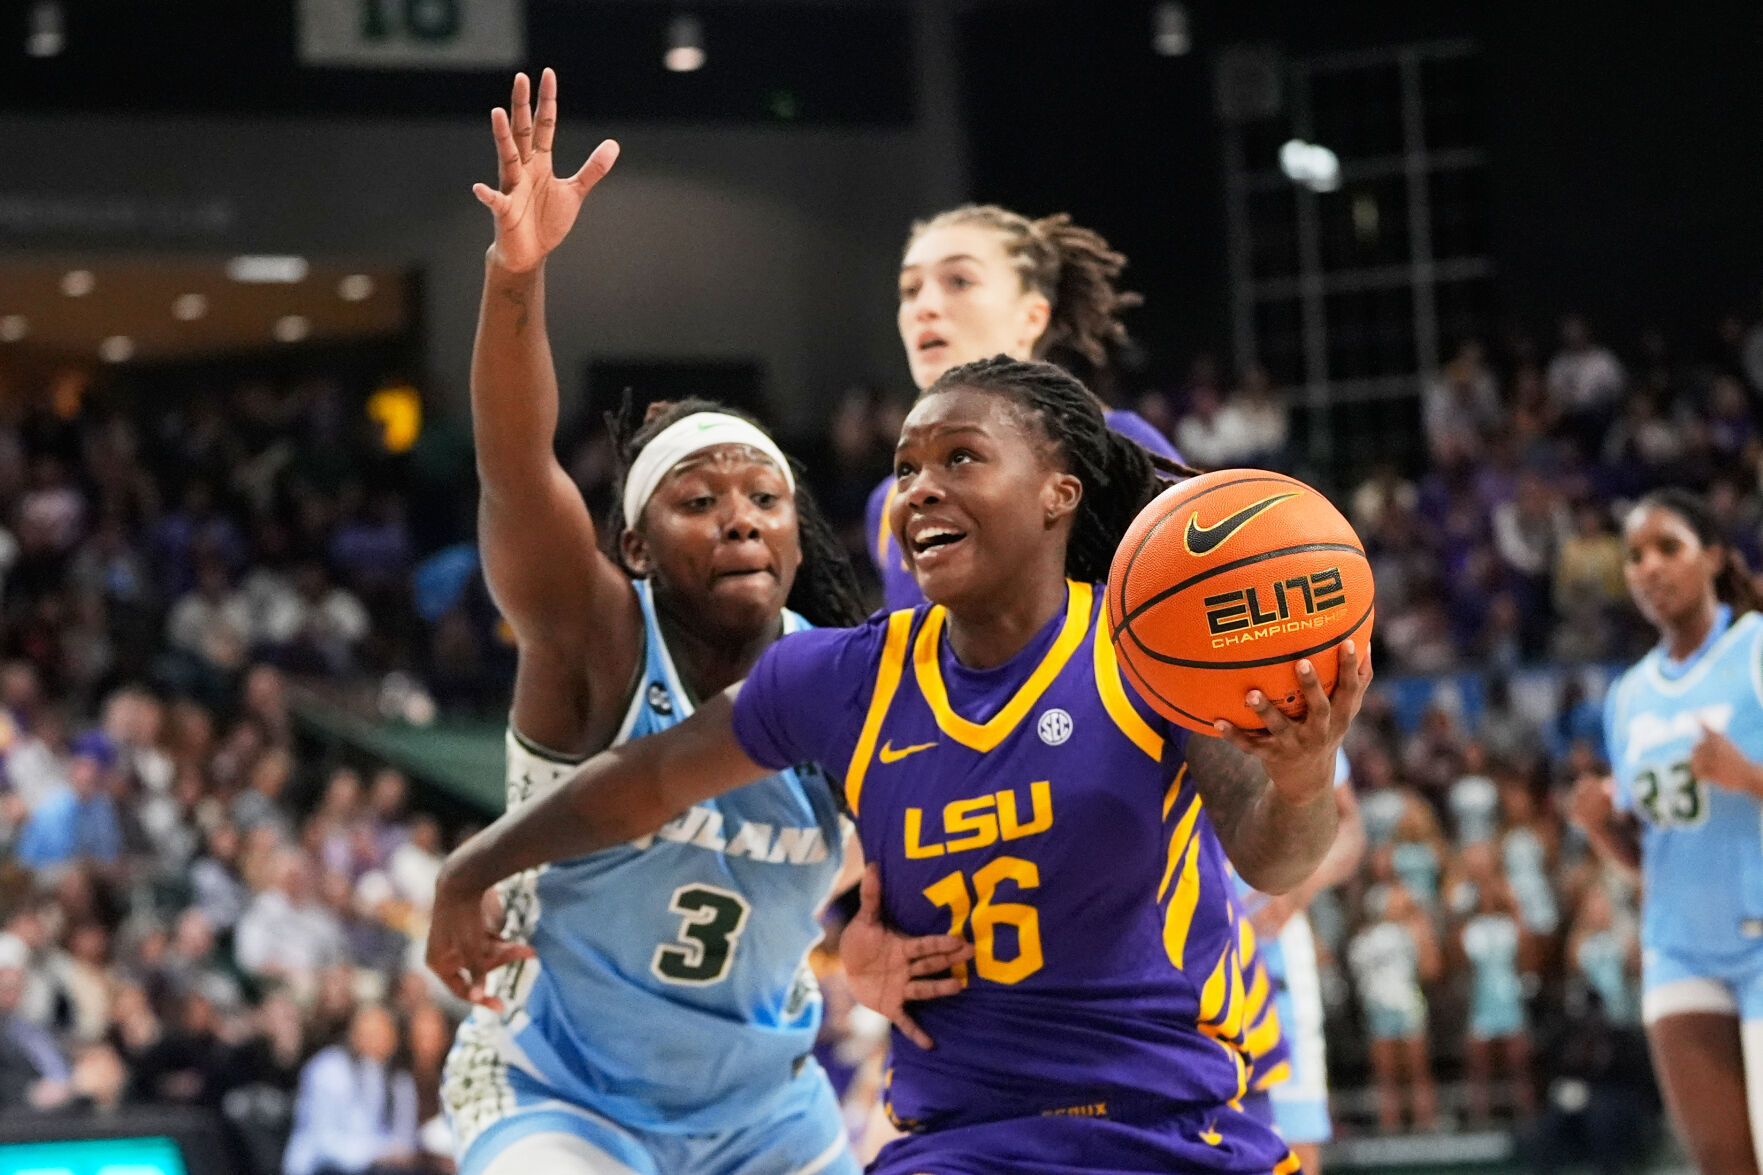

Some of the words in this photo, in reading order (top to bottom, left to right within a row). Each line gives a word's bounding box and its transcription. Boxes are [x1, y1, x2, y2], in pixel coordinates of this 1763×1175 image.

[1204, 567, 1346, 636] ELITE
[1040, 711, 1071, 742] SEC
[904, 780, 1053, 859] LSU
[651, 882, 751, 988] 3
[922, 855, 1044, 985] 16
